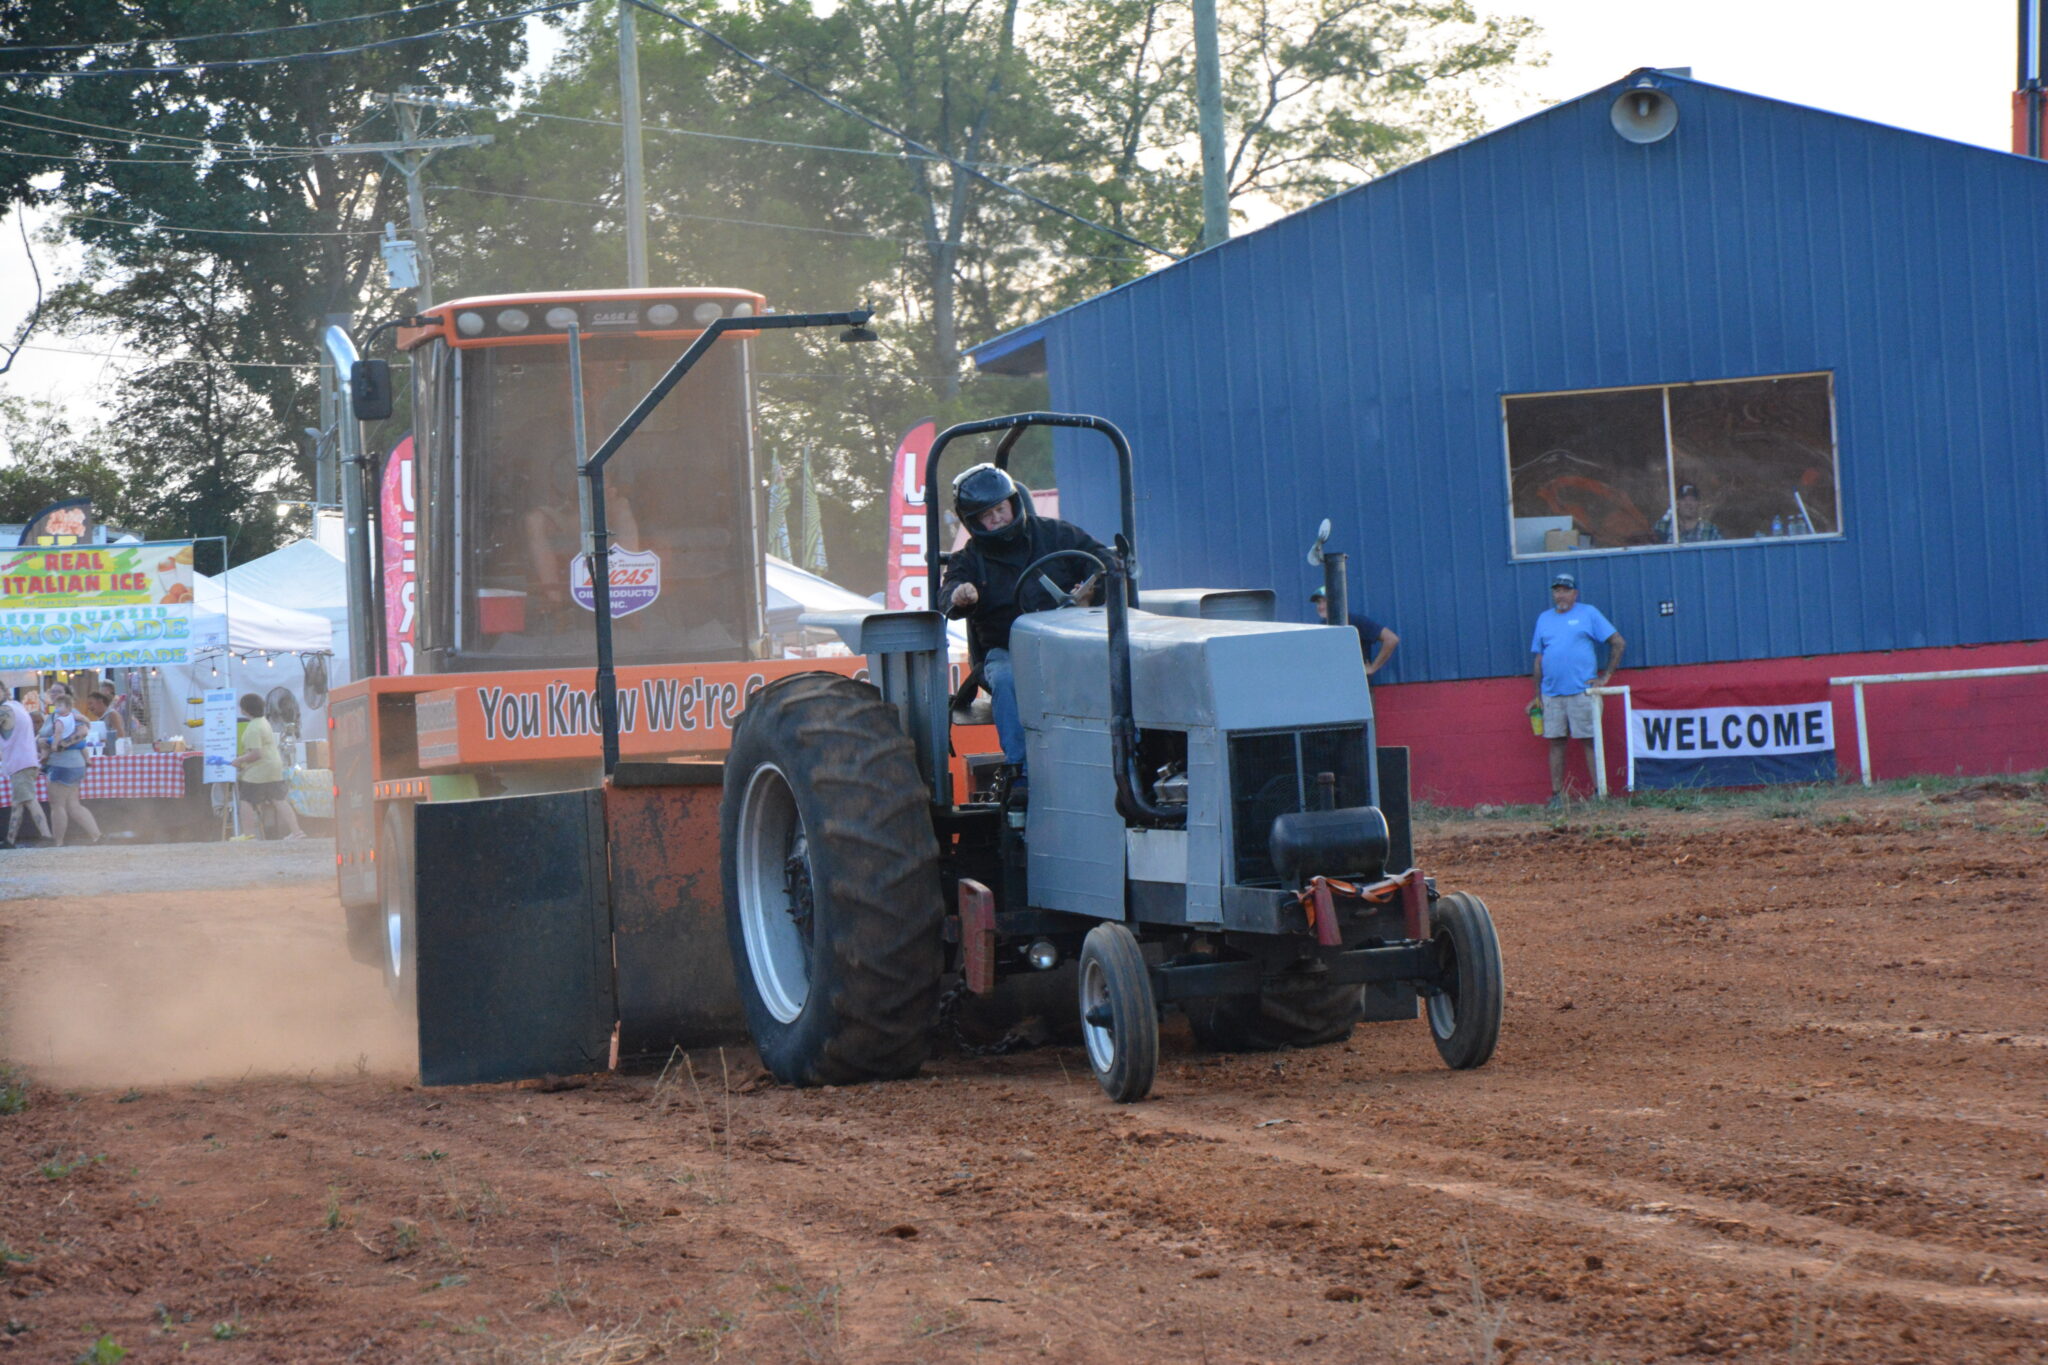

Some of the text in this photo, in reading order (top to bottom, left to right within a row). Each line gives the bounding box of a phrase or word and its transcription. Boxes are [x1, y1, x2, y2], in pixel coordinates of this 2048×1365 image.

[593, 312, 625, 321] CASE
[44, 553, 104, 571] REAL
[3, 572, 147, 594] ITALIAN ICE
[609, 601, 628, 609] NC.
[0, 607, 168, 625] ESH SQUEEZED
[60, 648, 188, 668] LEMONADE
[477, 686, 541, 740] You
[546, 682, 639, 737] Know
[642, 677, 738, 732] We're
[1643, 710, 1825, 751] WELCOME
